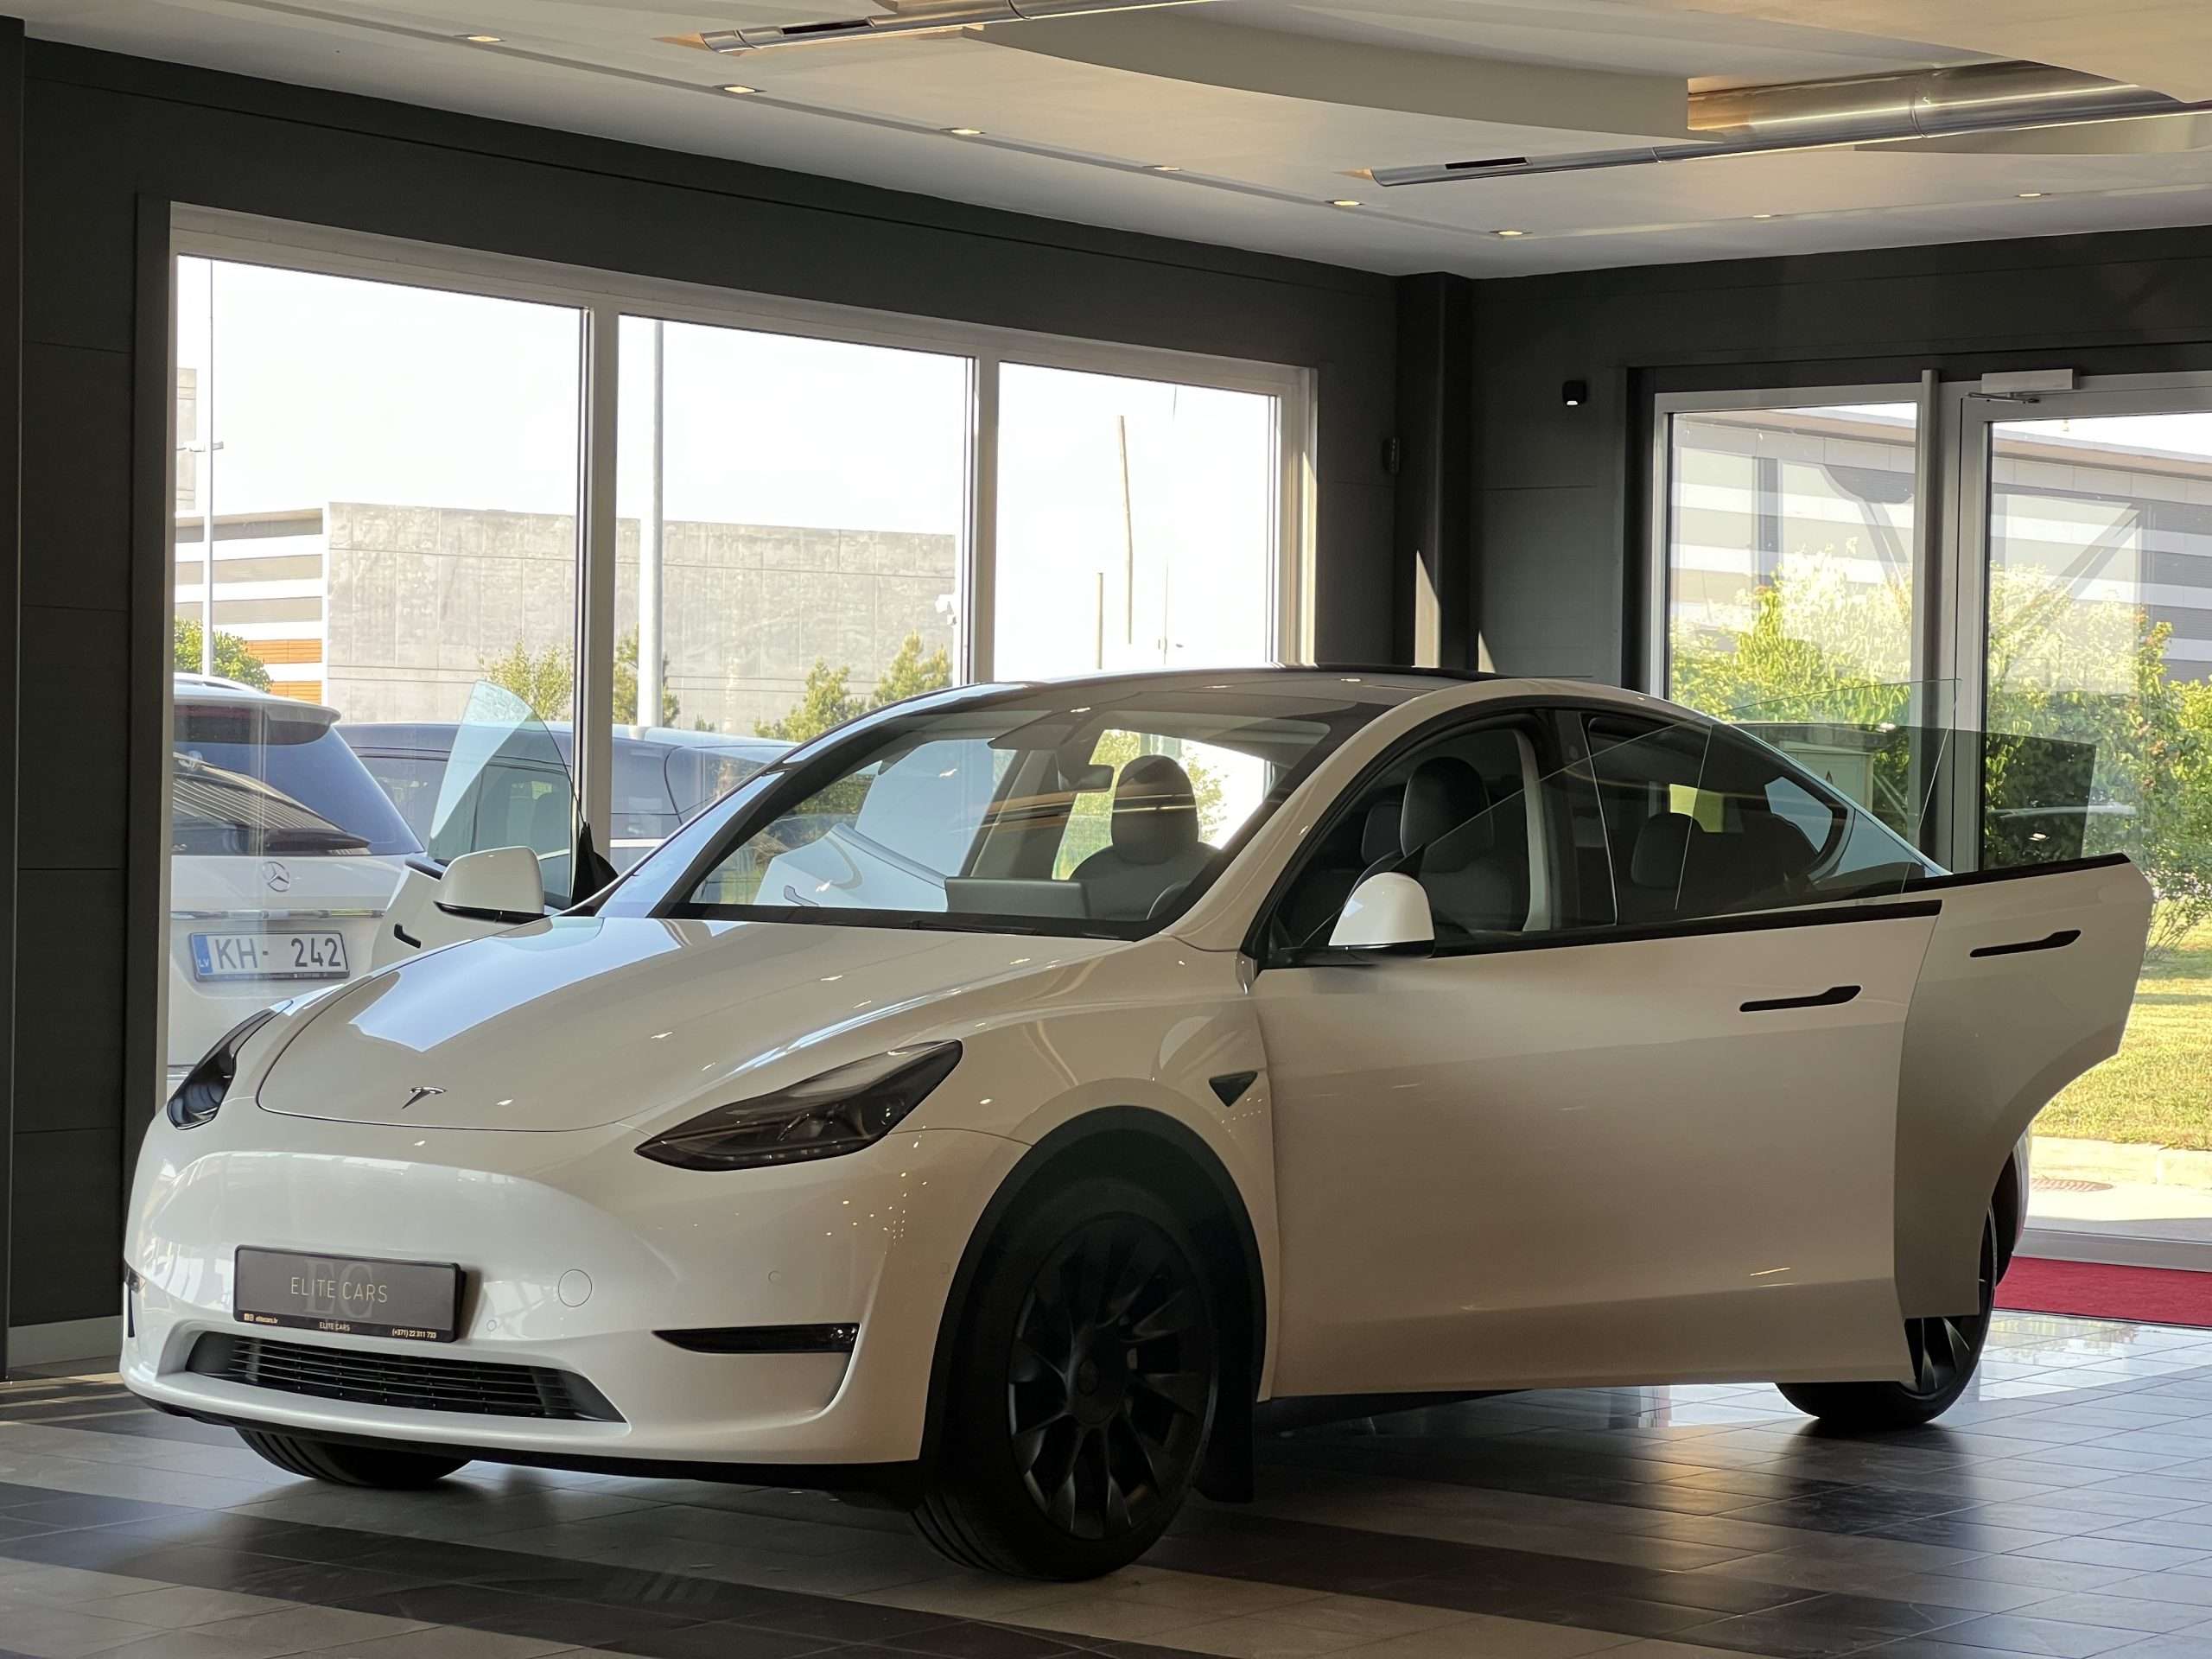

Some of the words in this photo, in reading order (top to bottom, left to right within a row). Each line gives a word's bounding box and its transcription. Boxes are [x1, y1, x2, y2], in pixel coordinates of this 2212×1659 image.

[198, 957, 210, 968] LV
[290, 938, 342, 968] 242
[290, 1276, 337, 1299] ELITE
[342, 1281, 388, 1303] CARS
[303, 1258, 373, 1319] EC
[319, 1321, 334, 1330] ELITE
[335, 1323, 351, 1332] CARS
